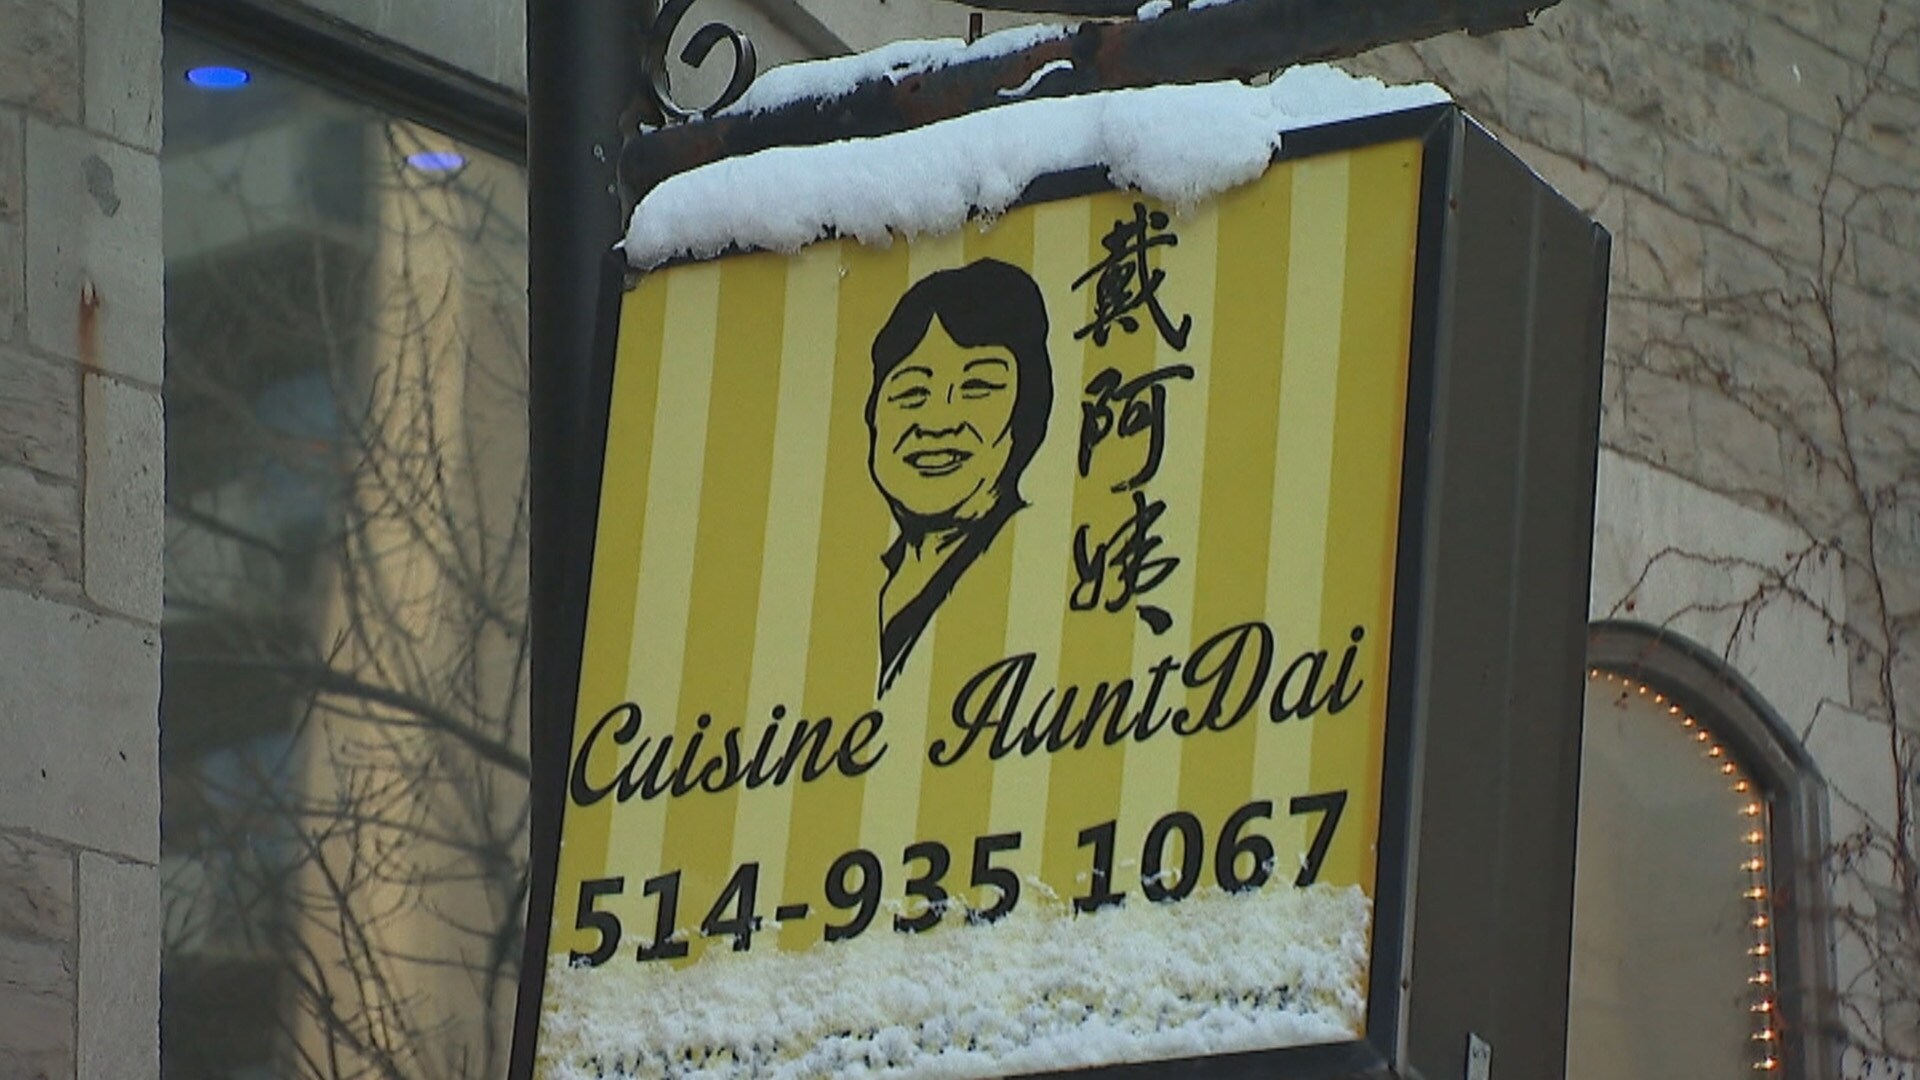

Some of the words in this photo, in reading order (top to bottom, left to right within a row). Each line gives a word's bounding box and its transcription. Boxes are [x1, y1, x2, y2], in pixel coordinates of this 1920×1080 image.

[1070, 201, 1195, 636] 戴阿姨
[569, 702, 888, 808] Cuisine
[568, 832, 1022, 970] 514-935
[1072, 789, 1349, 919] 1067
